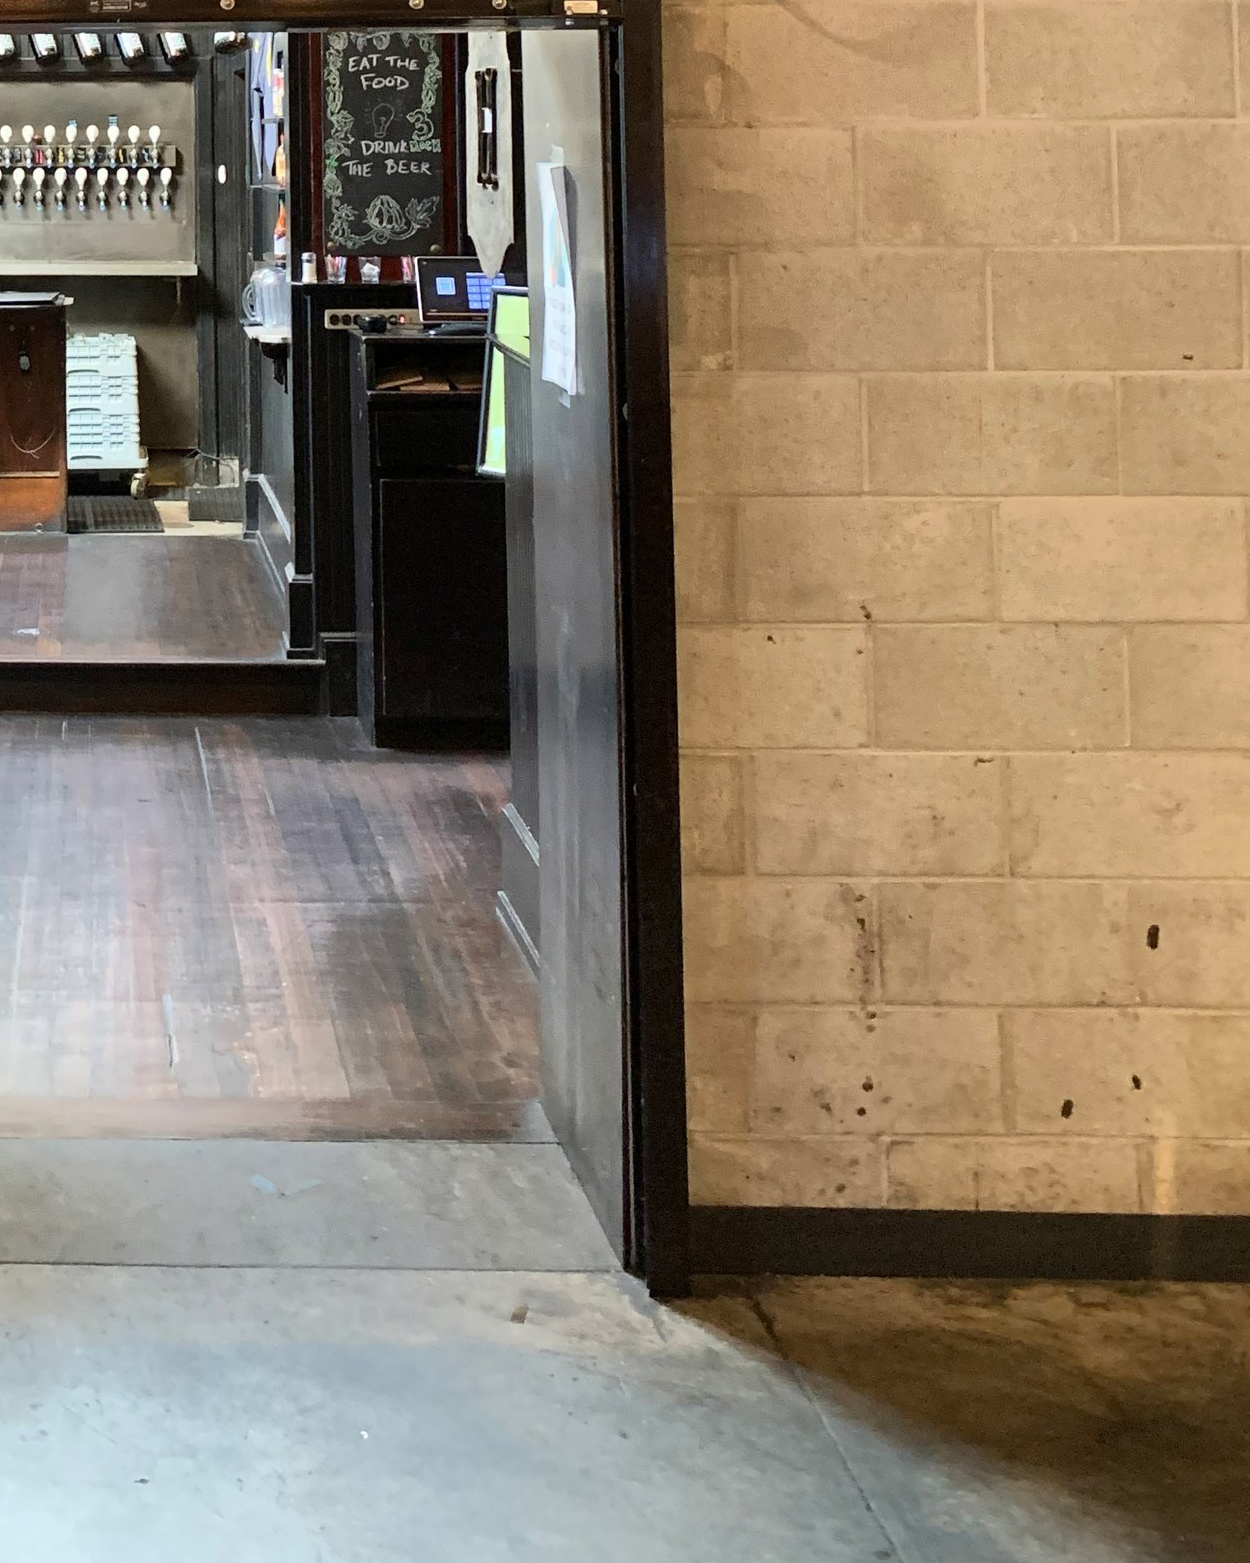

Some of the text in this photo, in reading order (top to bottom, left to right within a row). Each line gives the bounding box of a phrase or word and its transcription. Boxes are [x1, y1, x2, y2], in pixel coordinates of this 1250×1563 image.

[348, 54, 420, 72] EAT THE
[360, 73, 409, 91] FOOD
[360, 140, 409, 156] DRINK
[342, 158, 432, 177] THE BEER
